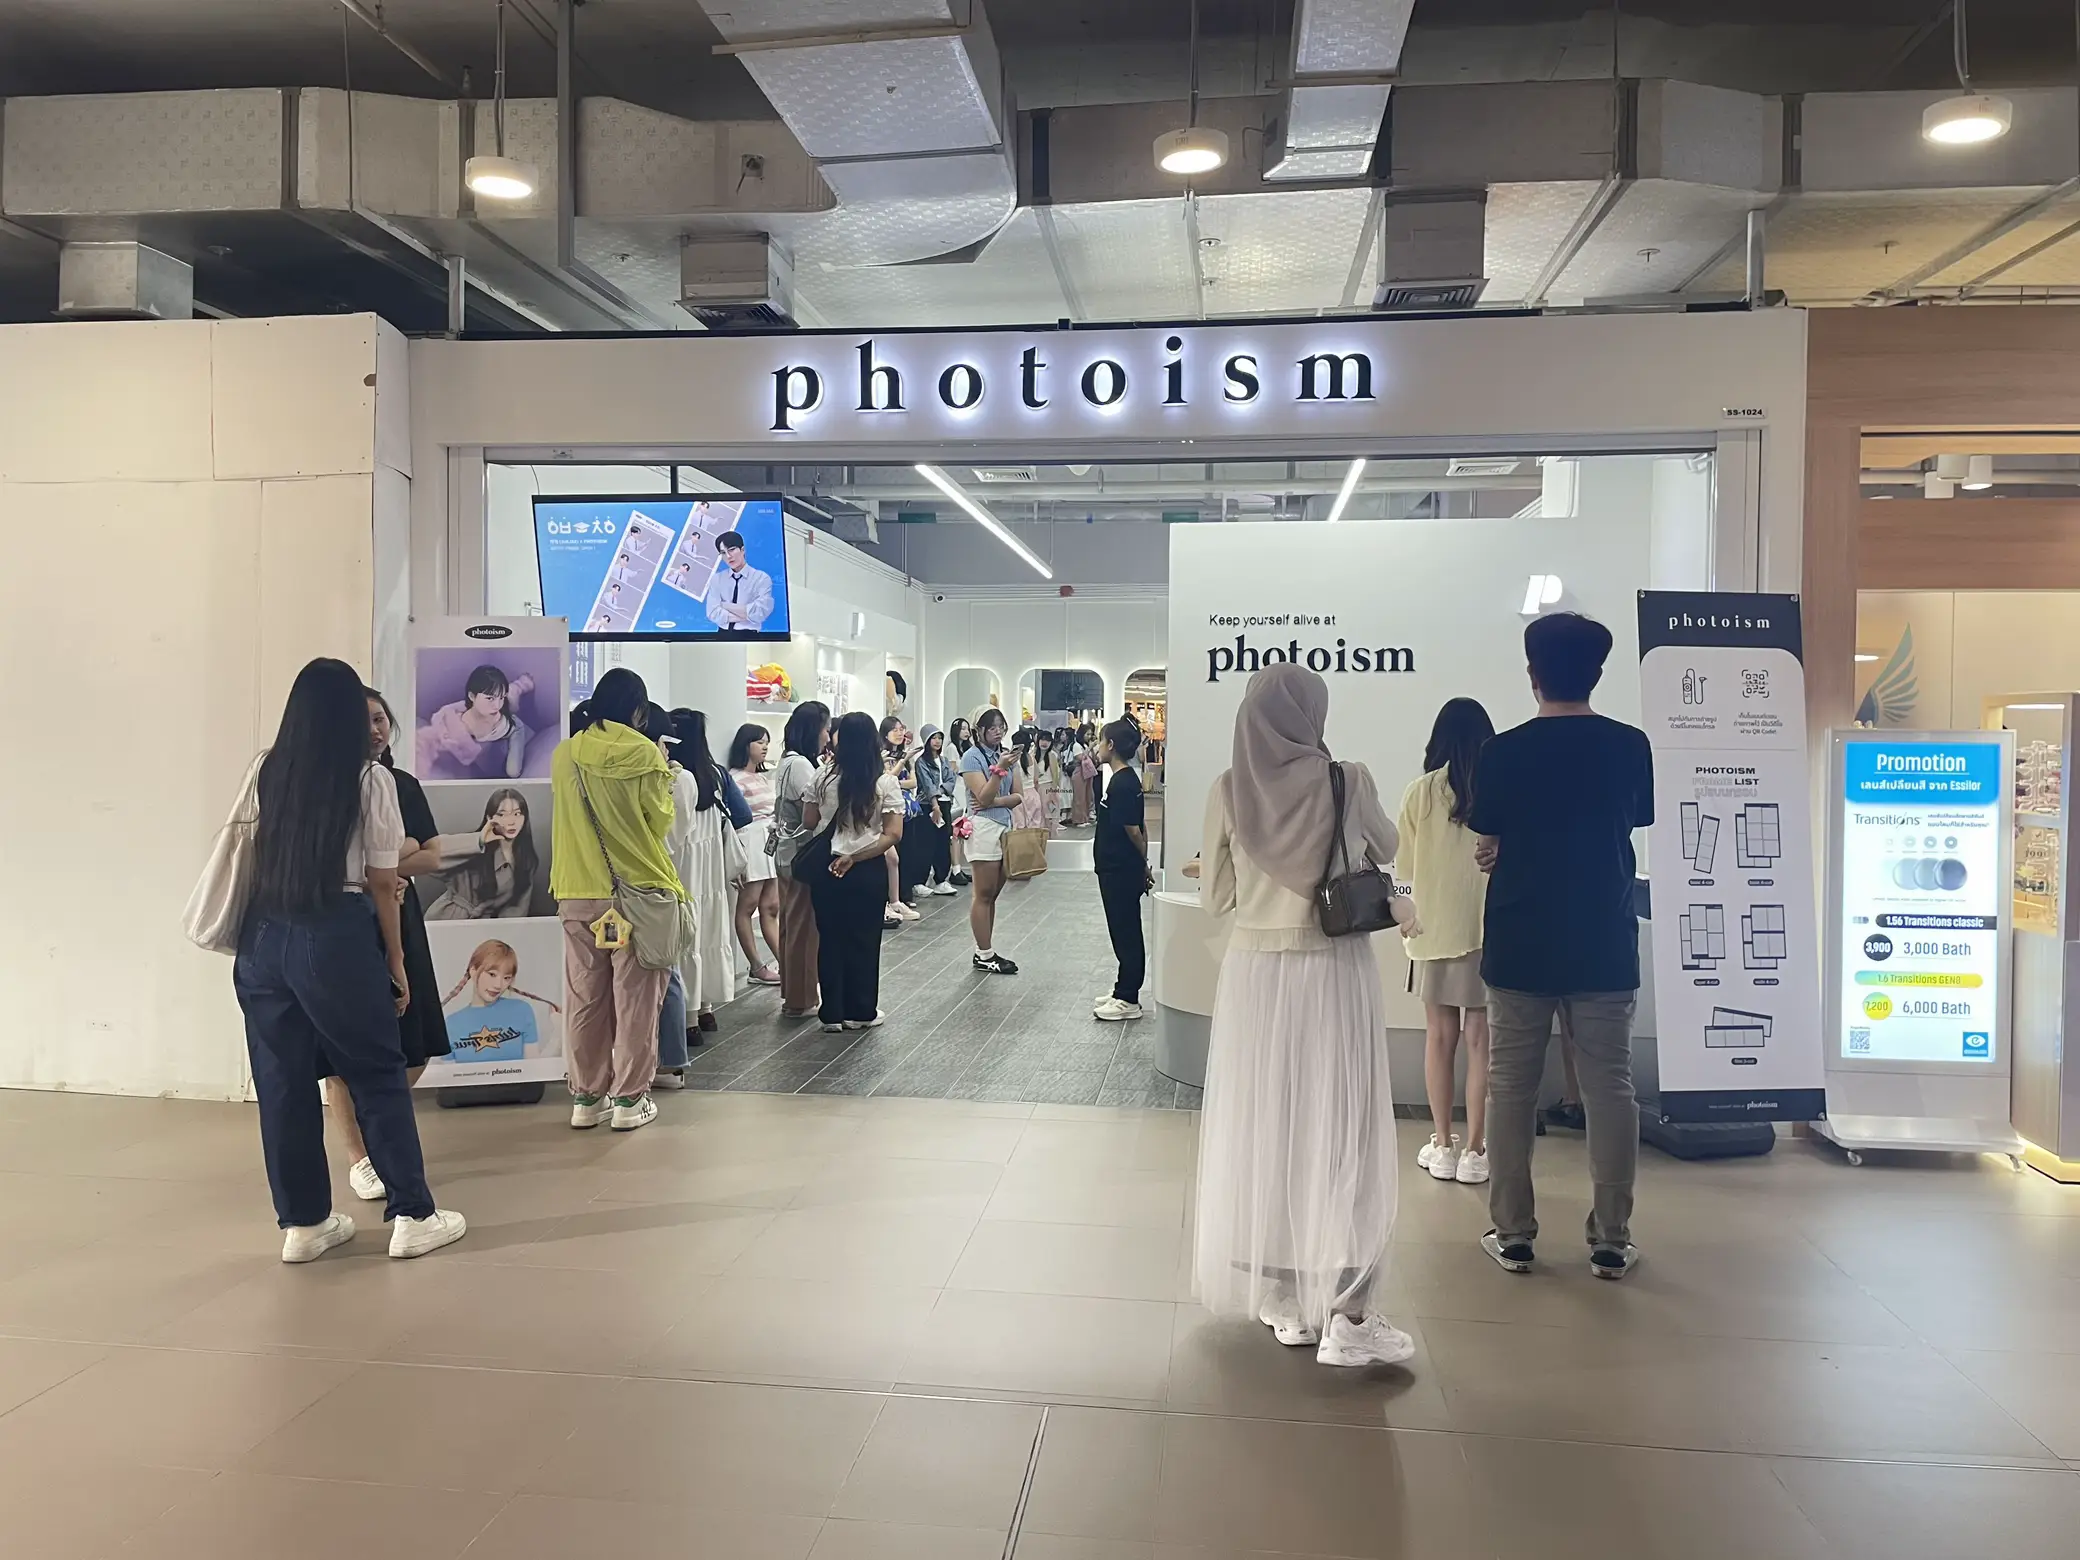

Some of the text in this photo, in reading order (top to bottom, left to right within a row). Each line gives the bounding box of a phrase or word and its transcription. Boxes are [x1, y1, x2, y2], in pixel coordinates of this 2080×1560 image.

[769, 335, 1376, 431] photoism
[1727, 408, 1763, 416] SS-1024
[1209, 614, 1336, 628] Keep yourself alive at
[1668, 613, 1770, 630] photoism
[472, 628, 506, 637] photoism
[1206, 634, 1416, 683] photoism
[1876, 753, 1966, 772] Promotion
[1695, 767, 1756, 775] PHOTOISM
[1734, 778, 1760, 786] LIST
[1928, 782, 1948, 791] จาก
[1950, 780, 1982, 791] Essilor
[1854, 813, 1921, 827] Transitions
[1886, 916, 1984, 927] 1.56 Transitions classic
[1865, 942, 1971, 956] 3,900 3,000 Bath
[1890, 974, 1937, 984] Transitions
[1865, 1001, 1971, 1015] 7,200 6,000 Bath
[491, 1067, 522, 1077] photoism
